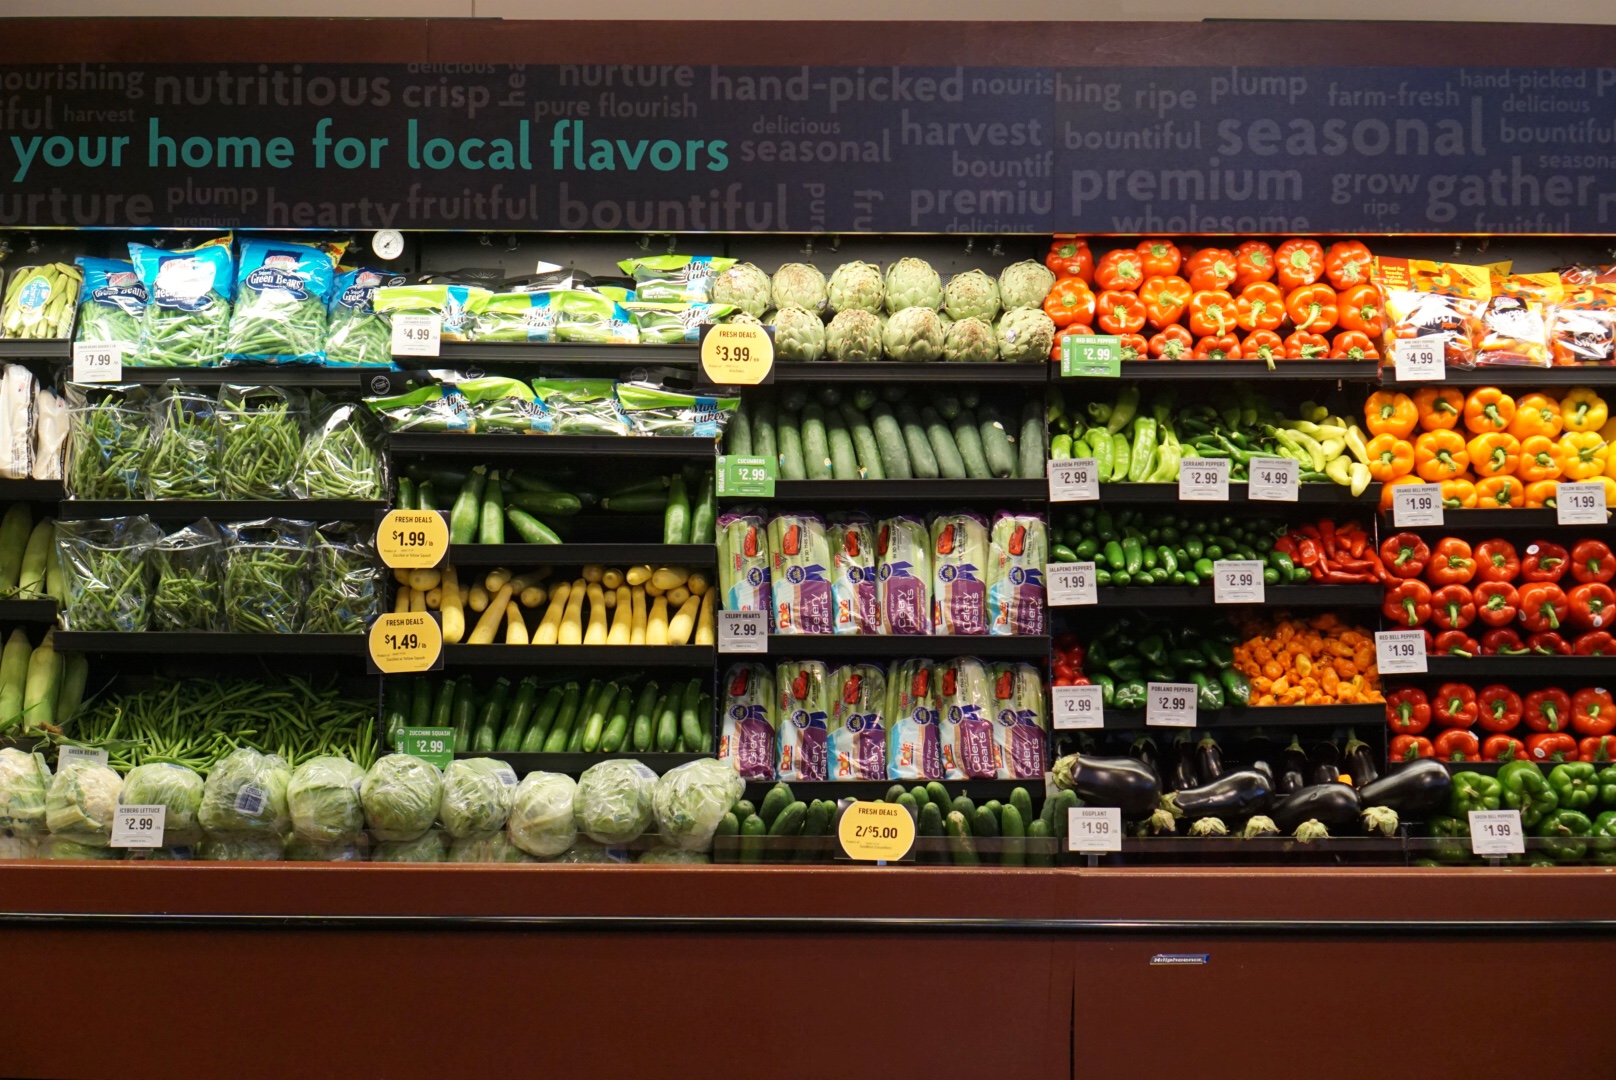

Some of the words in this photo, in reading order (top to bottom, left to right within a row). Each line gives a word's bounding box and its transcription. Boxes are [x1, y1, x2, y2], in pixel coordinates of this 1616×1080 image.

[154, 64, 392, 106] nutritious
[559, 64, 695, 87] nurture
[710, 65, 964, 113] hand-picked
[1210, 66, 1308, 105] plump
[1459, 68, 1586, 93] hand-picked
[402, 77, 490, 119] crisp
[534, 99, 591, 123] pure
[599, 92, 698, 118] flourish
[1135, 82, 1197, 118] ripe
[1328, 82, 1460, 107] farm-fresh
[1502, 94, 1591, 113] delicious
[63, 104, 135, 122] harvest
[752, 115, 841, 134] delicious
[1217, 96, 1486, 156] seasonal
[901, 108, 1042, 146] harvest
[1065, 120, 1202, 150] bountiful
[10, 136, 130, 183] your
[148, 117, 295, 168] home
[312, 117, 389, 169] for
[407, 118, 533, 170] local
[550, 119, 729, 171] flavors
[740, 129, 892, 163] seasonal
[952, 150, 1053, 177] bountif
[167, 177, 259, 214] plump
[1072, 157, 1303, 216] premium
[1331, 173, 1420, 204] grow
[1425, 156, 1596, 223] gather
[266, 186, 399, 229] hearty
[406, 182, 539, 221] fruitful
[559, 182, 789, 231] bountiful
[910, 180, 1053, 226] premiu
[1363, 198, 1400, 219] ripe
[1112, 204, 1310, 232] wholesome
[250, 272, 274, 284] Green
[275, 272, 301, 290] Beans
[403, 328, 430, 340] $4.99
[719, 331, 738, 339] FRESH
[738, 331, 757, 339] DEALS
[85, 354, 111, 366] $7.99
[1083, 348, 1110, 360] $2.99
[1406, 352, 1433, 364] $4.99
[691, 402, 718, 412] Mini
[693, 412, 724, 424] Cukes
[738, 468, 765, 481] $2.99
[1060, 471, 1087, 484] $2.99
[1191, 472, 1218, 484] $2.99
[1261, 471, 1288, 484] $4.99
[1406, 497, 1432, 510] $1.99
[1569, 496, 1595, 508] $1.99
[1059, 575, 1085, 588] $1.99
[1226, 574, 1252, 586] $2.99
[780, 602, 790, 629] Dole
[811, 594, 822, 635] Celery
[821, 592, 832, 635] Hearts
[897, 589, 907, 628] Celery
[906, 588, 915, 628] Hearts
[961, 591, 971, 630] Celery
[971, 592, 980, 629] Hearts
[386, 619, 405, 627] FRESH
[405, 618, 424, 626] DEALS
[730, 623, 757, 636] $2.99
[1389, 644, 1415, 656] $1.99
[1064, 699, 1091, 712] $2.99
[1159, 697, 1185, 710] $2.99
[416, 740, 443, 753] $2.99
[748, 730, 759, 765] Celery
[758, 732, 767, 766] Hearts
[781, 744, 791, 771] Dole
[809, 740, 822, 780] Celery
[900, 741, 911, 766] Dole
[970, 729, 982, 773] Celery
[979, 731, 990, 772] Hearts
[1022, 736, 1033, 777] Celery
[1032, 737, 1040, 776] Hearts
[870, 741, 880, 781] Celery
[125, 818, 153, 830] $2.99
[858, 807, 878, 816] FRESH
[879, 808, 898, 816] DEALS
[855, 825, 898, 839] 2/$5.00
[1082, 821, 1109, 834] $1.99
[1483, 824, 1511, 836] $1.99
